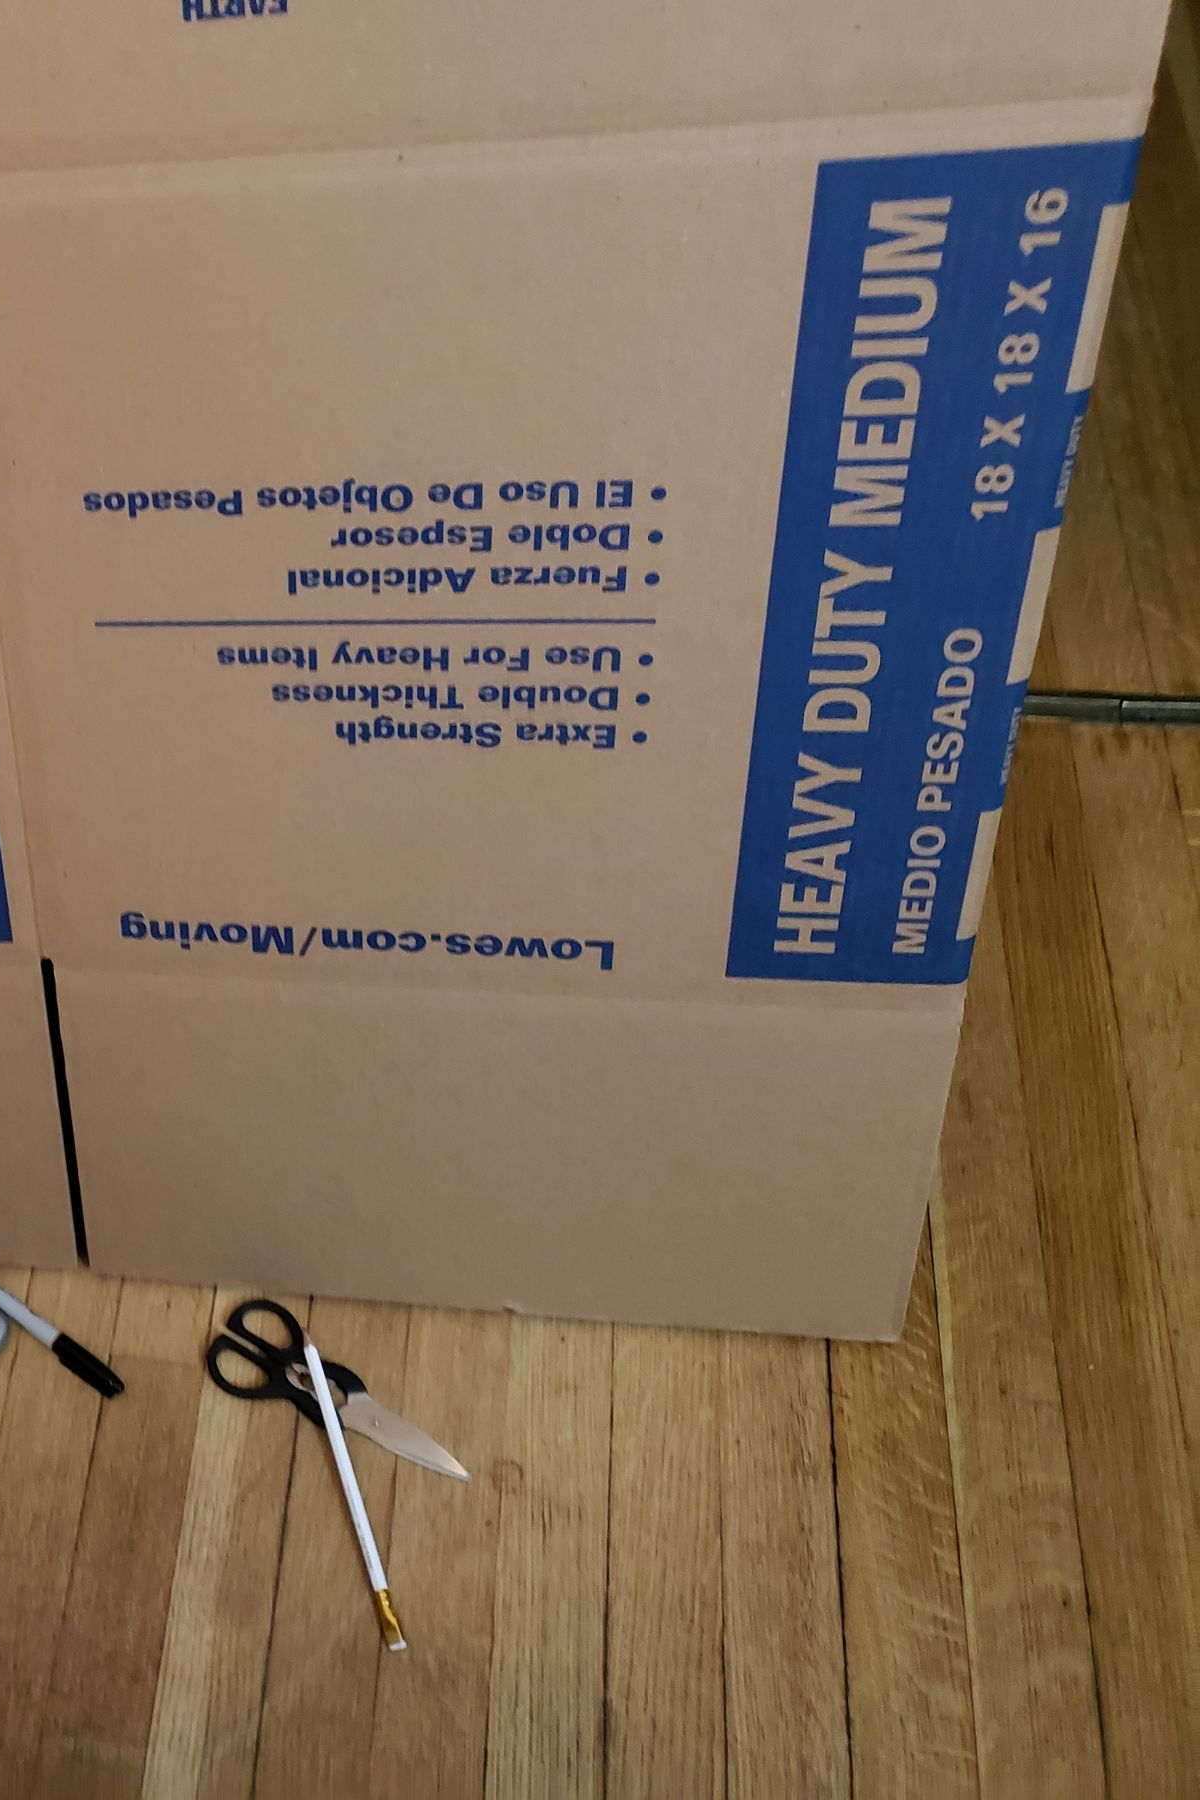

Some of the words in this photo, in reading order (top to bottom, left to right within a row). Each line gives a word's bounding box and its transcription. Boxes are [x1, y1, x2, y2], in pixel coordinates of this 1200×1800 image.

[1020, 187, 1069, 255] 16
[1006, 278, 1052, 313] X
[829, 198, 952, 527] MEDIUM
[994, 333, 1039, 394] 18
[980, 415, 1025, 447] X
[83, 488, 243, 518] Pesados
[256, 479, 414, 513] Objetos
[428, 482, 484, 511] De
[498, 480, 580, 509] Uso
[595, 479, 634, 510] El
[971, 464, 1013, 521] 18
[330, 520, 494, 554] Espesor
[508, 521, 632, 552] Doble
[288, 566, 476, 595] Adicional
[490, 565, 628, 593] Fuerza
[333, 641, 450, 673] Heavy
[803, 550, 893, 732] DUTY
[217, 646, 319, 673] Items
[464, 645, 531, 673] For
[545, 644, 622, 673] Use
[271, 683, 464, 711] Thickness
[478, 684, 619, 713] Double
[336, 715, 502, 748] Strength
[516, 722, 617, 751] Extra
[916, 628, 983, 813] PESADO
[773, 753, 862, 954] HEAVY
[892, 826, 946, 955] MEDIO
[119, 911, 615, 971] Lowes.com/Moving
